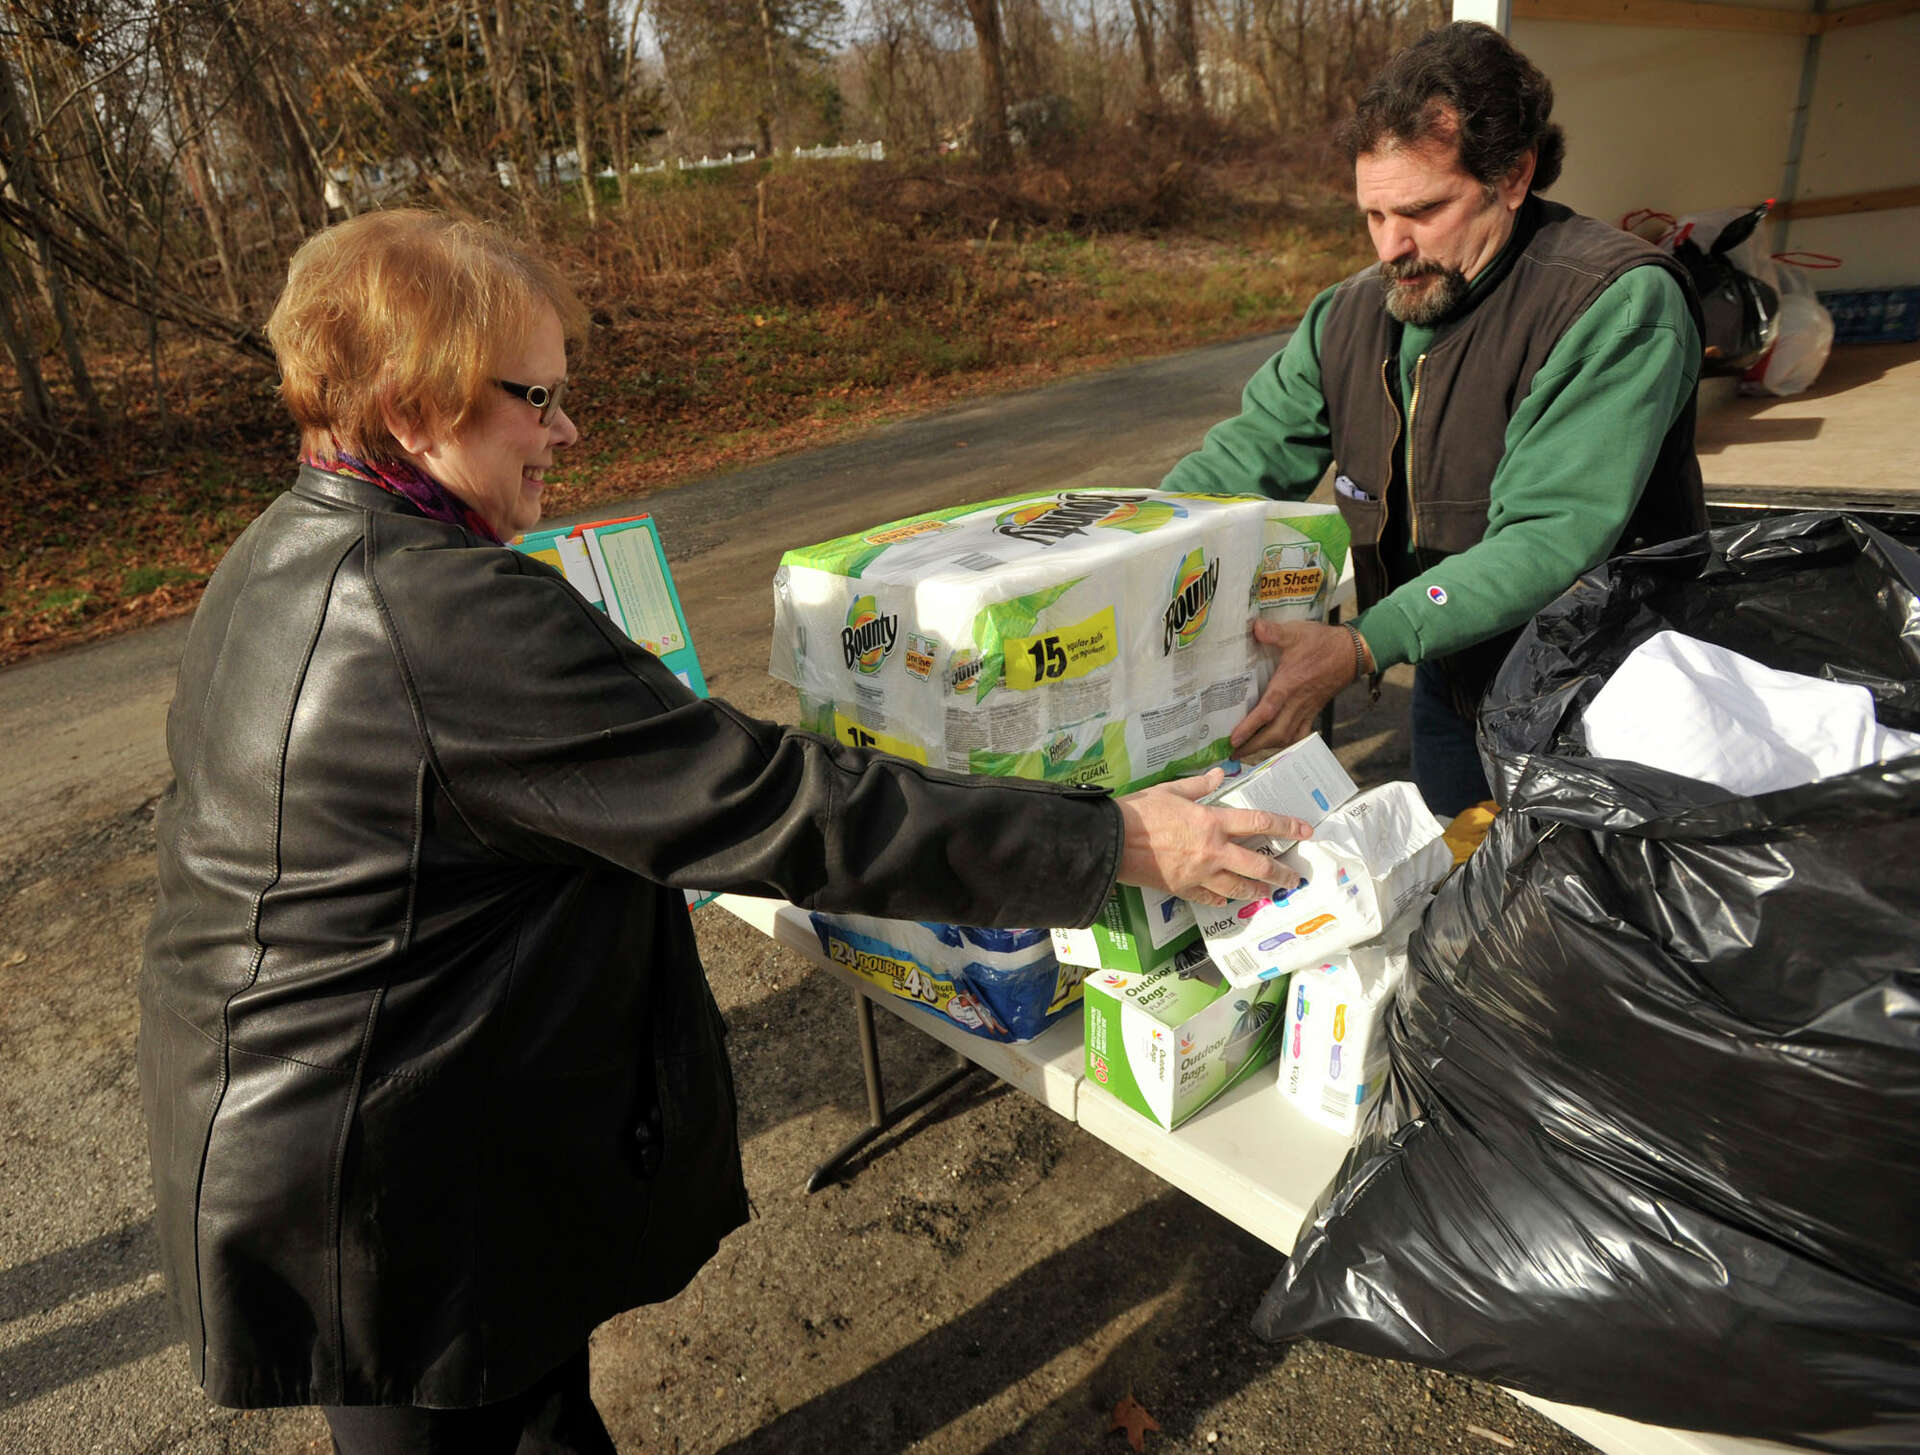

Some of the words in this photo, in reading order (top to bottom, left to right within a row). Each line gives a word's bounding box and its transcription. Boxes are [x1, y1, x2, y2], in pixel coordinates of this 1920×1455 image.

[1282, 571, 1321, 586] Sheet
[1163, 556, 1220, 657] Bounty
[841, 610, 898, 671] Bounty
[1027, 635, 1068, 682] 15
[1081, 762, 1110, 783] CLEAN!
[1202, 916, 1237, 938] kotex
[829, 940, 860, 971] 24
[857, 953, 908, 980] DOUBLE
[903, 966, 939, 1004] 48
[1124, 965, 1173, 998] Outdoor
[1137, 985, 1168, 1006] Bags
[1180, 1035, 1227, 1071] Outdoor
[1095, 1056, 1110, 1083] 40
[1180, 1062, 1207, 1086] Bags
